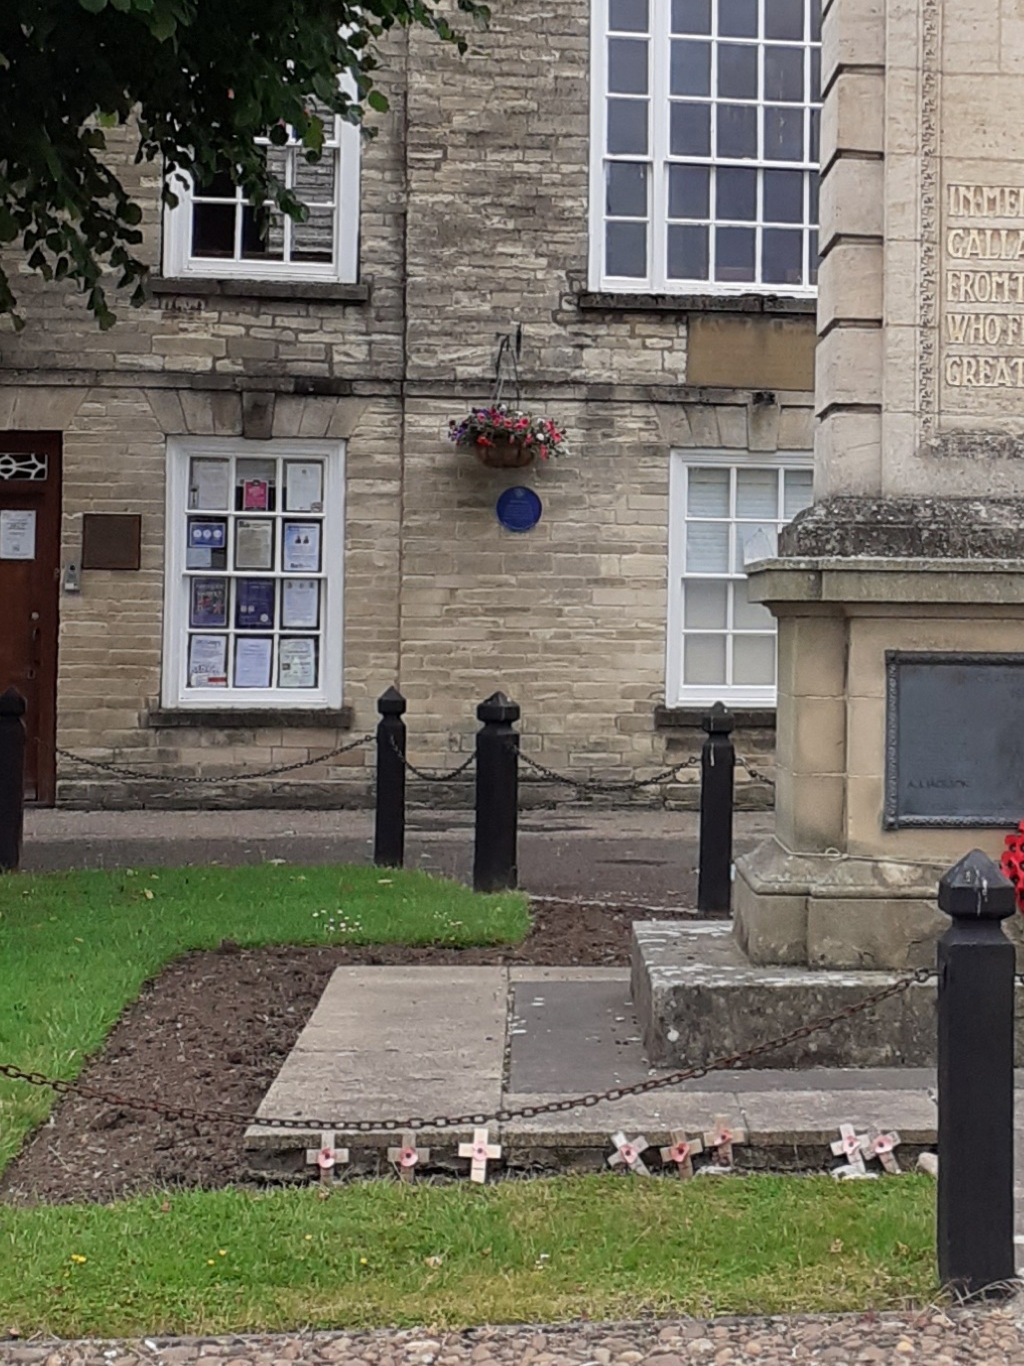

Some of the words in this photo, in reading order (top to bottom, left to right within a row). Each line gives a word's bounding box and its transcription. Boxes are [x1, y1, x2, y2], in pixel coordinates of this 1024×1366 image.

[948, 187, 975, 218] IN
[947, 271, 1009, 303] FROM
[946, 314, 1001, 345] WHO
